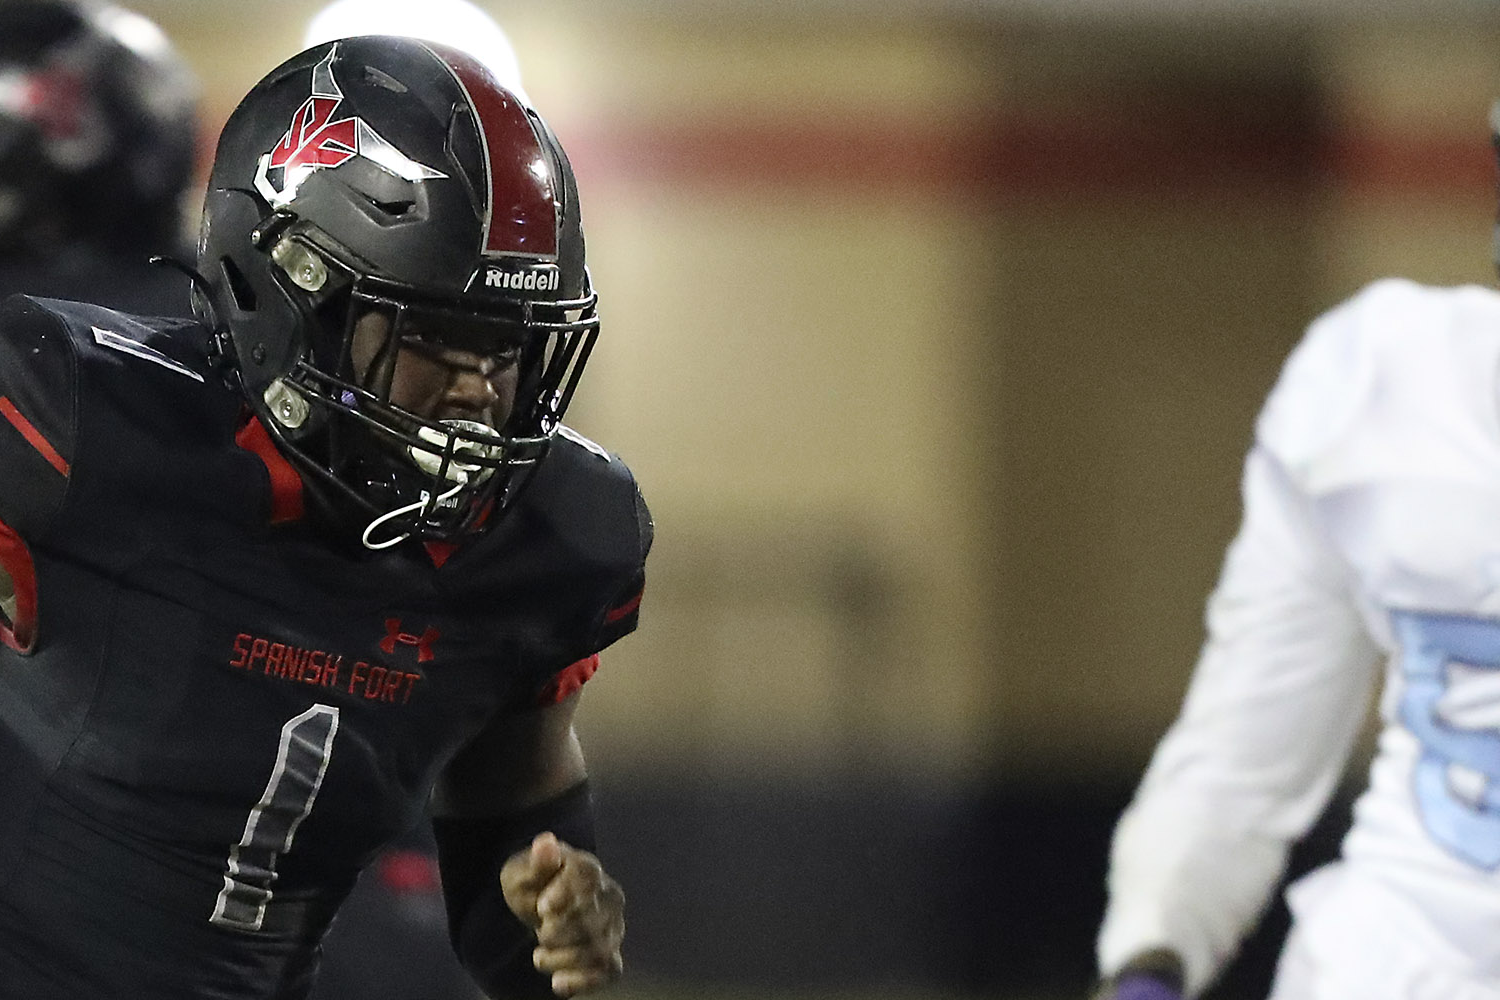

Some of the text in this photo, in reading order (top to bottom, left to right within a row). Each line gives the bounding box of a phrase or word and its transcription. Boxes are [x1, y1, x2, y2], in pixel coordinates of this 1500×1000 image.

[485, 269, 559, 290] Riddell
[230, 633, 421, 703] SPANISH FORT
[209, 703, 339, 931] 1
